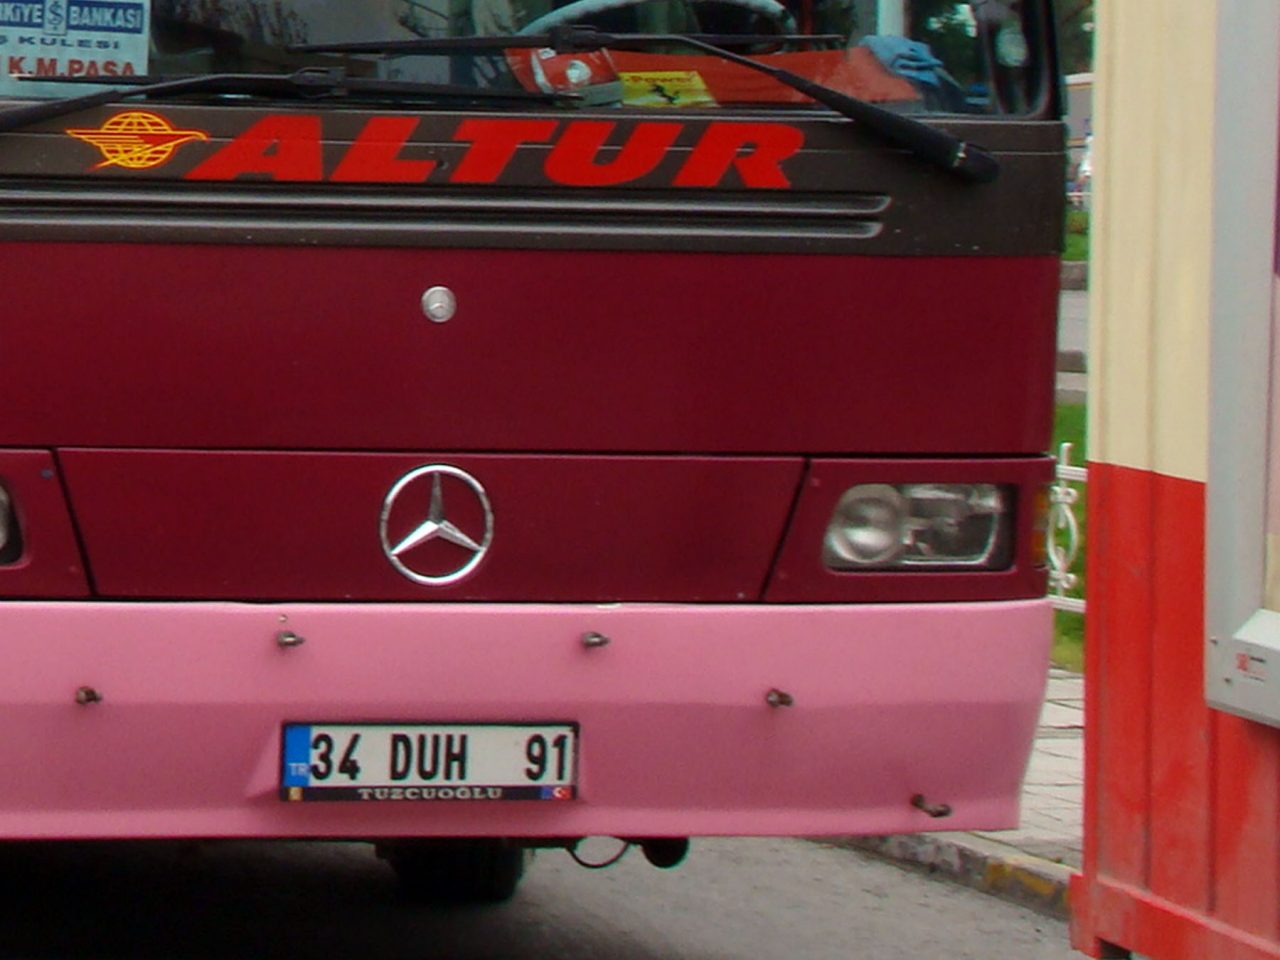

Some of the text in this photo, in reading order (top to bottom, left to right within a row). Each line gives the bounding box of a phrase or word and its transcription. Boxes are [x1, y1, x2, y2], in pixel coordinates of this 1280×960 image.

[183, 114, 806, 190] ALTUR
[287, 761, 310, 777] TR
[310, 733, 568, 782] 34 DUH 91
